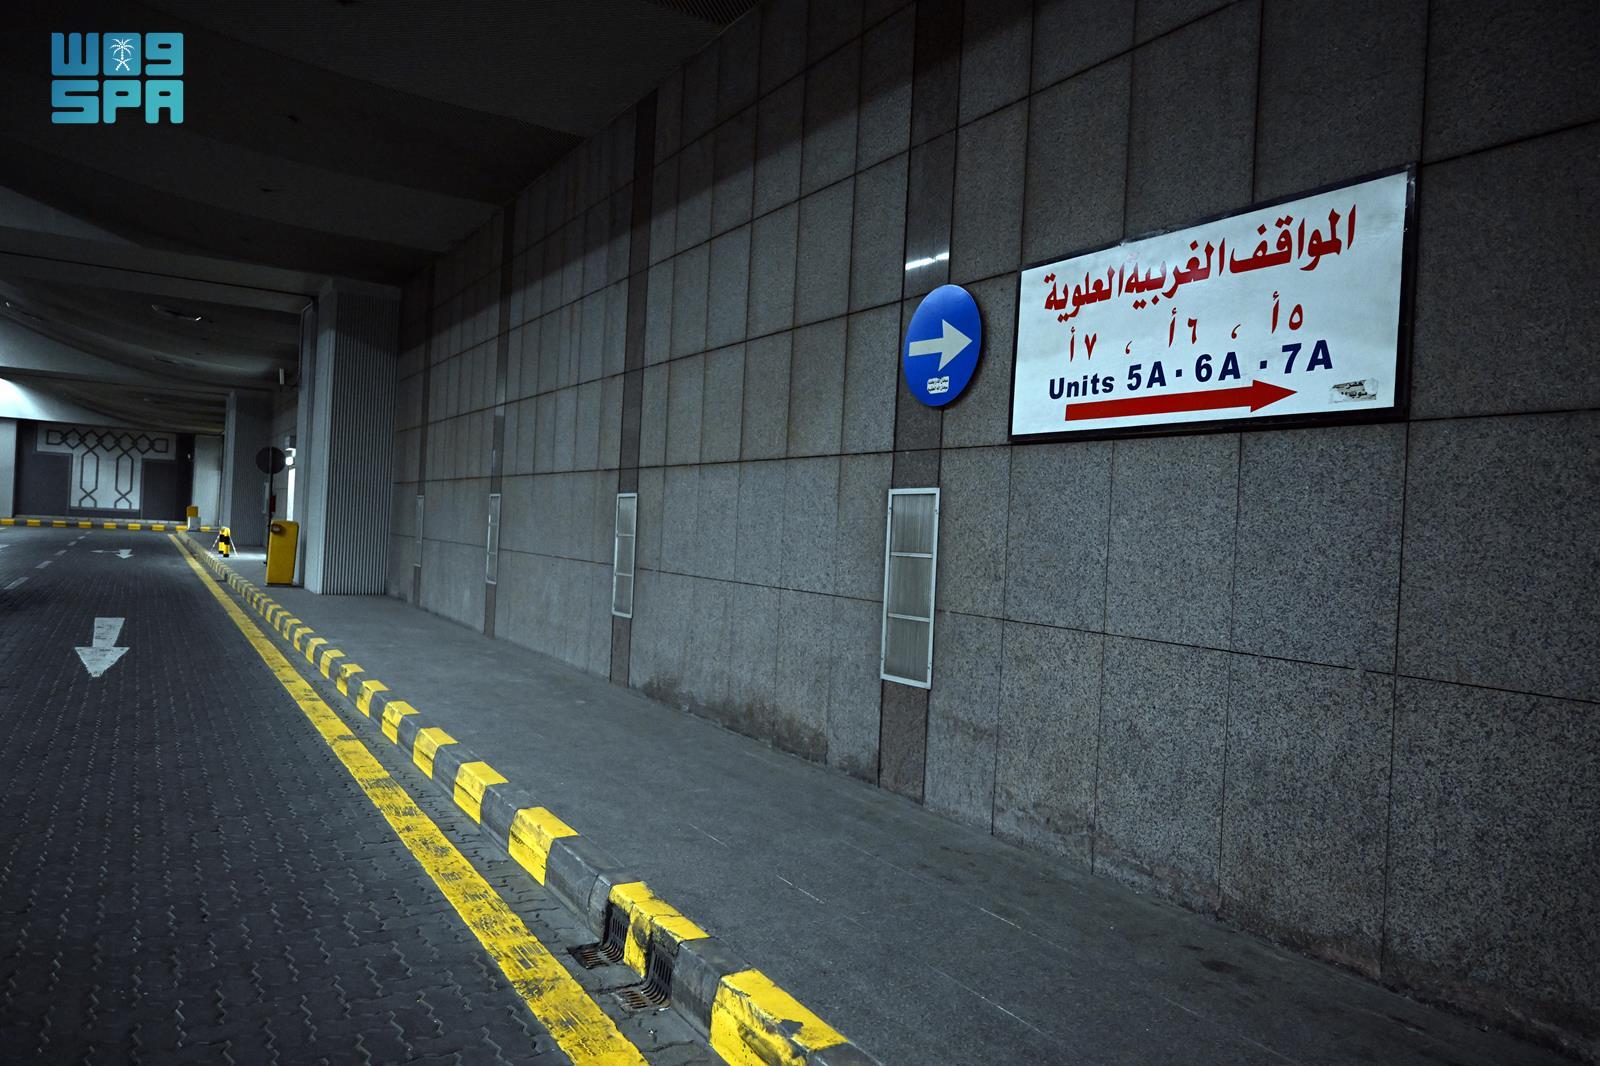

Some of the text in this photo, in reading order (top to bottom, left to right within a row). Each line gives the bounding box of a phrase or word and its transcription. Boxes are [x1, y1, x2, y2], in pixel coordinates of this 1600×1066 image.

[1230, 203, 1356, 274] المواقف
[1044, 263, 1125, 323] العلوية
[1049, 373, 1115, 399] Units
[1127, 361, 1167, 391] 5A
[1195, 352, 1241, 383] 6A
[1281, 340, 1333, 374] 7A
